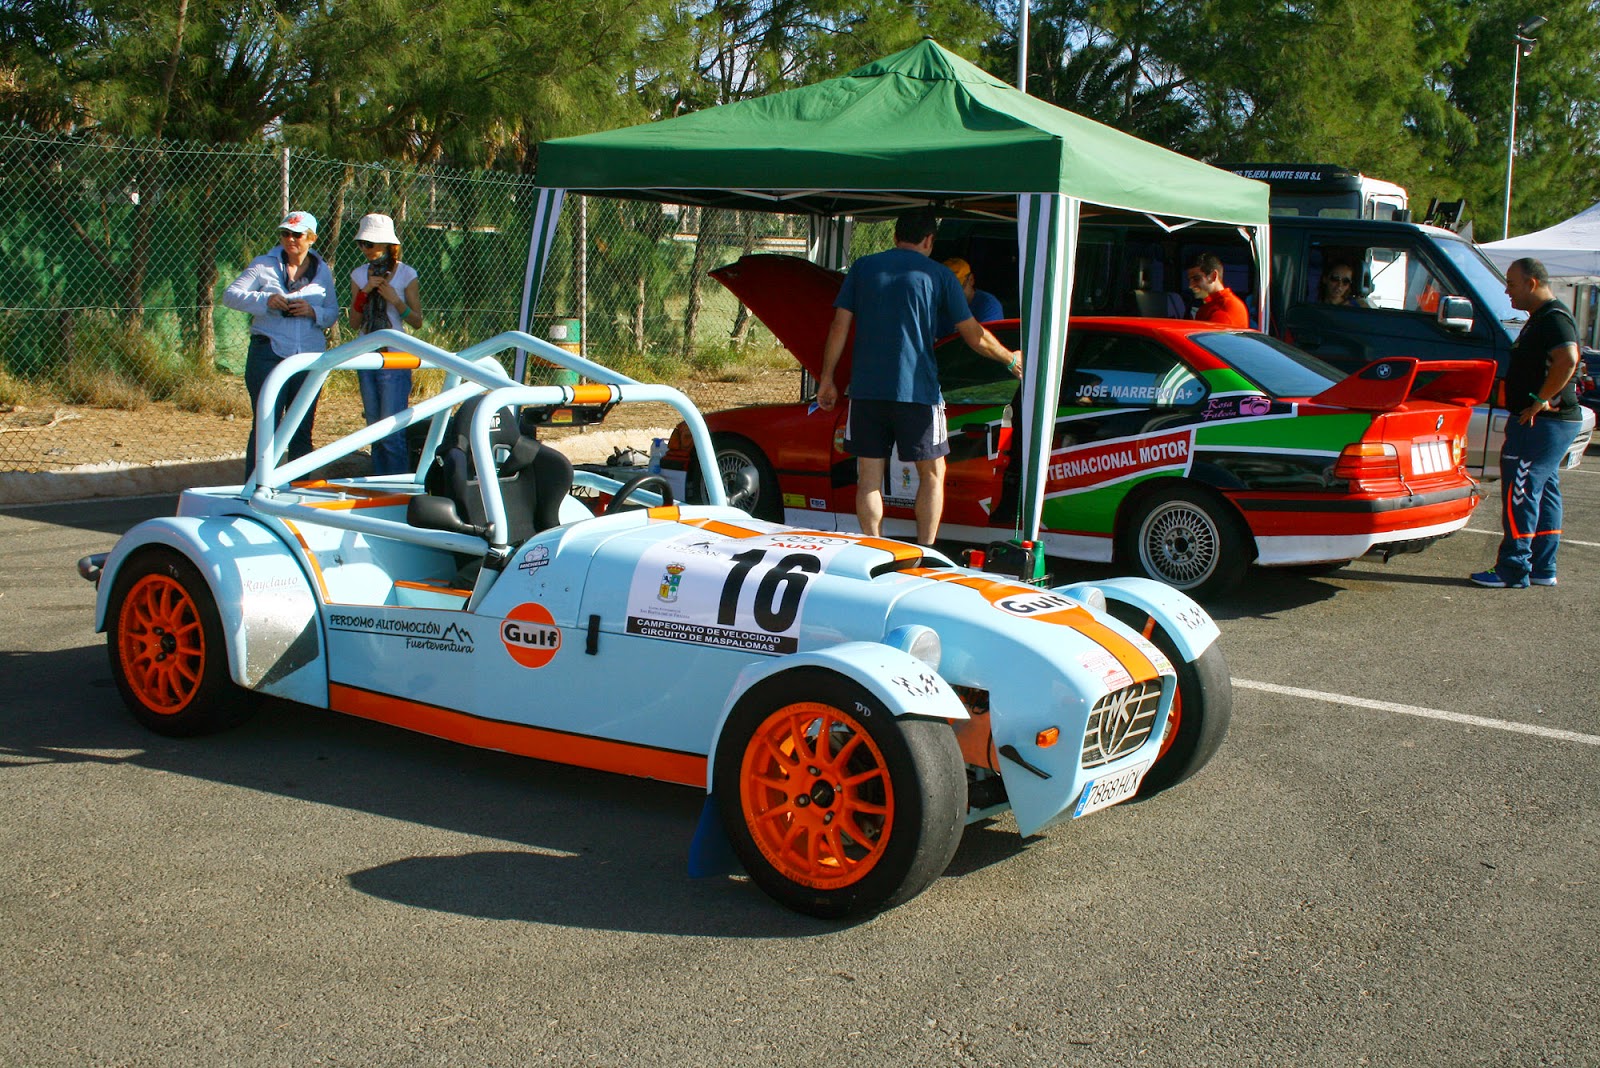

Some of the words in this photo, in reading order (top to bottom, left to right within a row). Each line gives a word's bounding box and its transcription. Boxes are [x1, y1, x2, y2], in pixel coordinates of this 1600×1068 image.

[1244, 170, 1268, 179] TEJERA
[1269, 171, 1294, 180] NORTE
[1294, 171, 1309, 180] SUR
[1075, 384, 1107, 398] JOSE
[1110, 386, 1173, 400] MARRERO
[1175, 388, 1193, 400] A+
[1208, 399, 1233, 409] Rosa
[1047, 450, 1136, 481] TERNACIONAL
[1140, 440, 1187, 463] MOTOR
[519, 559, 548, 569] MICHELIN
[717, 548, 821, 633] 16
[1001, 594, 1073, 614] Gulf
[330, 614, 374, 629] PERDOMO
[376, 619, 441, 635] AUTOMOCIÓN
[636, 618, 705, 634] CAMPEONATO
[706, 627, 720, 637] DE
[723, 630, 781, 644] VELOCIDAD
[406, 637, 475, 654] Fuerteventura
[504, 624, 558, 647] Gulf
[640, 627, 687, 641] CIRCUITO
[690, 633, 703, 643] DE
[705, 636, 775, 651] MASPALOMAS
